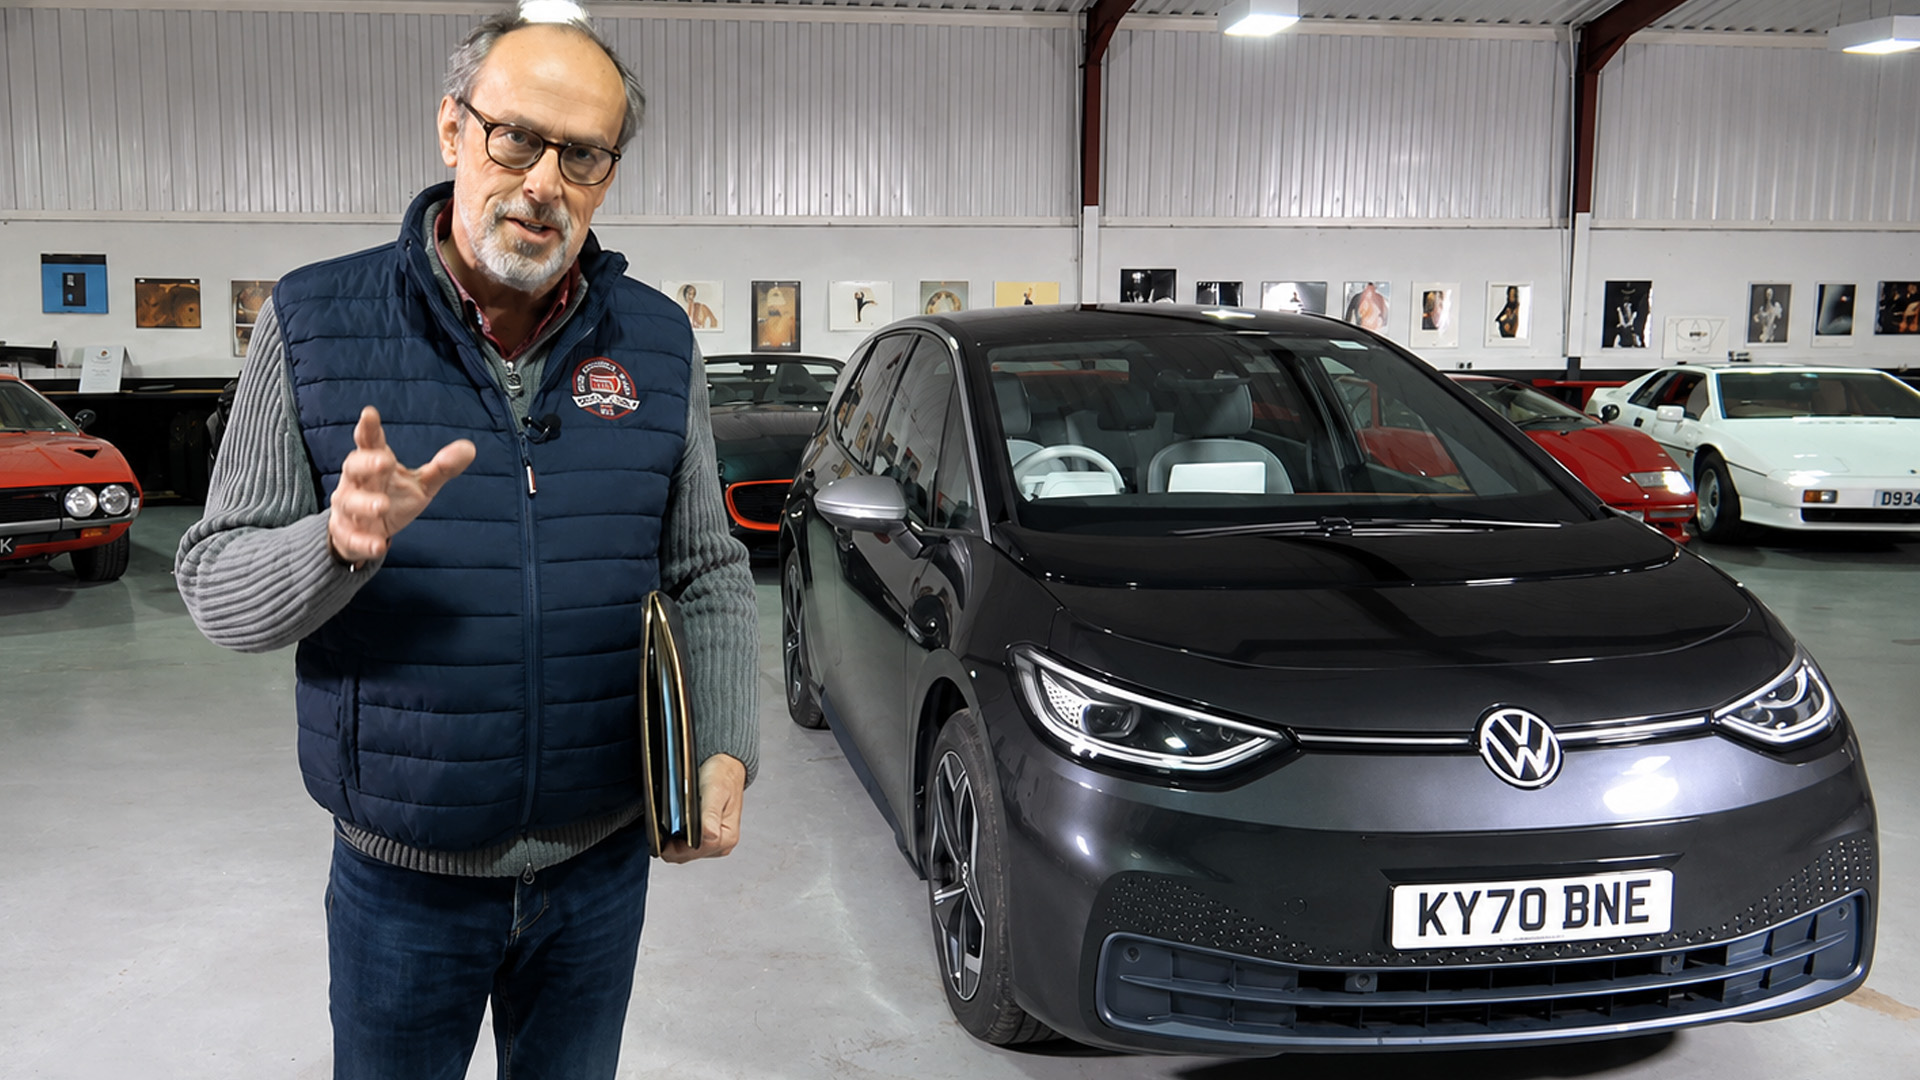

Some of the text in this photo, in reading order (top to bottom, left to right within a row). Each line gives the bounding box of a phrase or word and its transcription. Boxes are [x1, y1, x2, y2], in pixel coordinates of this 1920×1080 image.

[1482, 710, 1560, 783] VW
[1418, 879, 1652, 937] KY70 BNE
